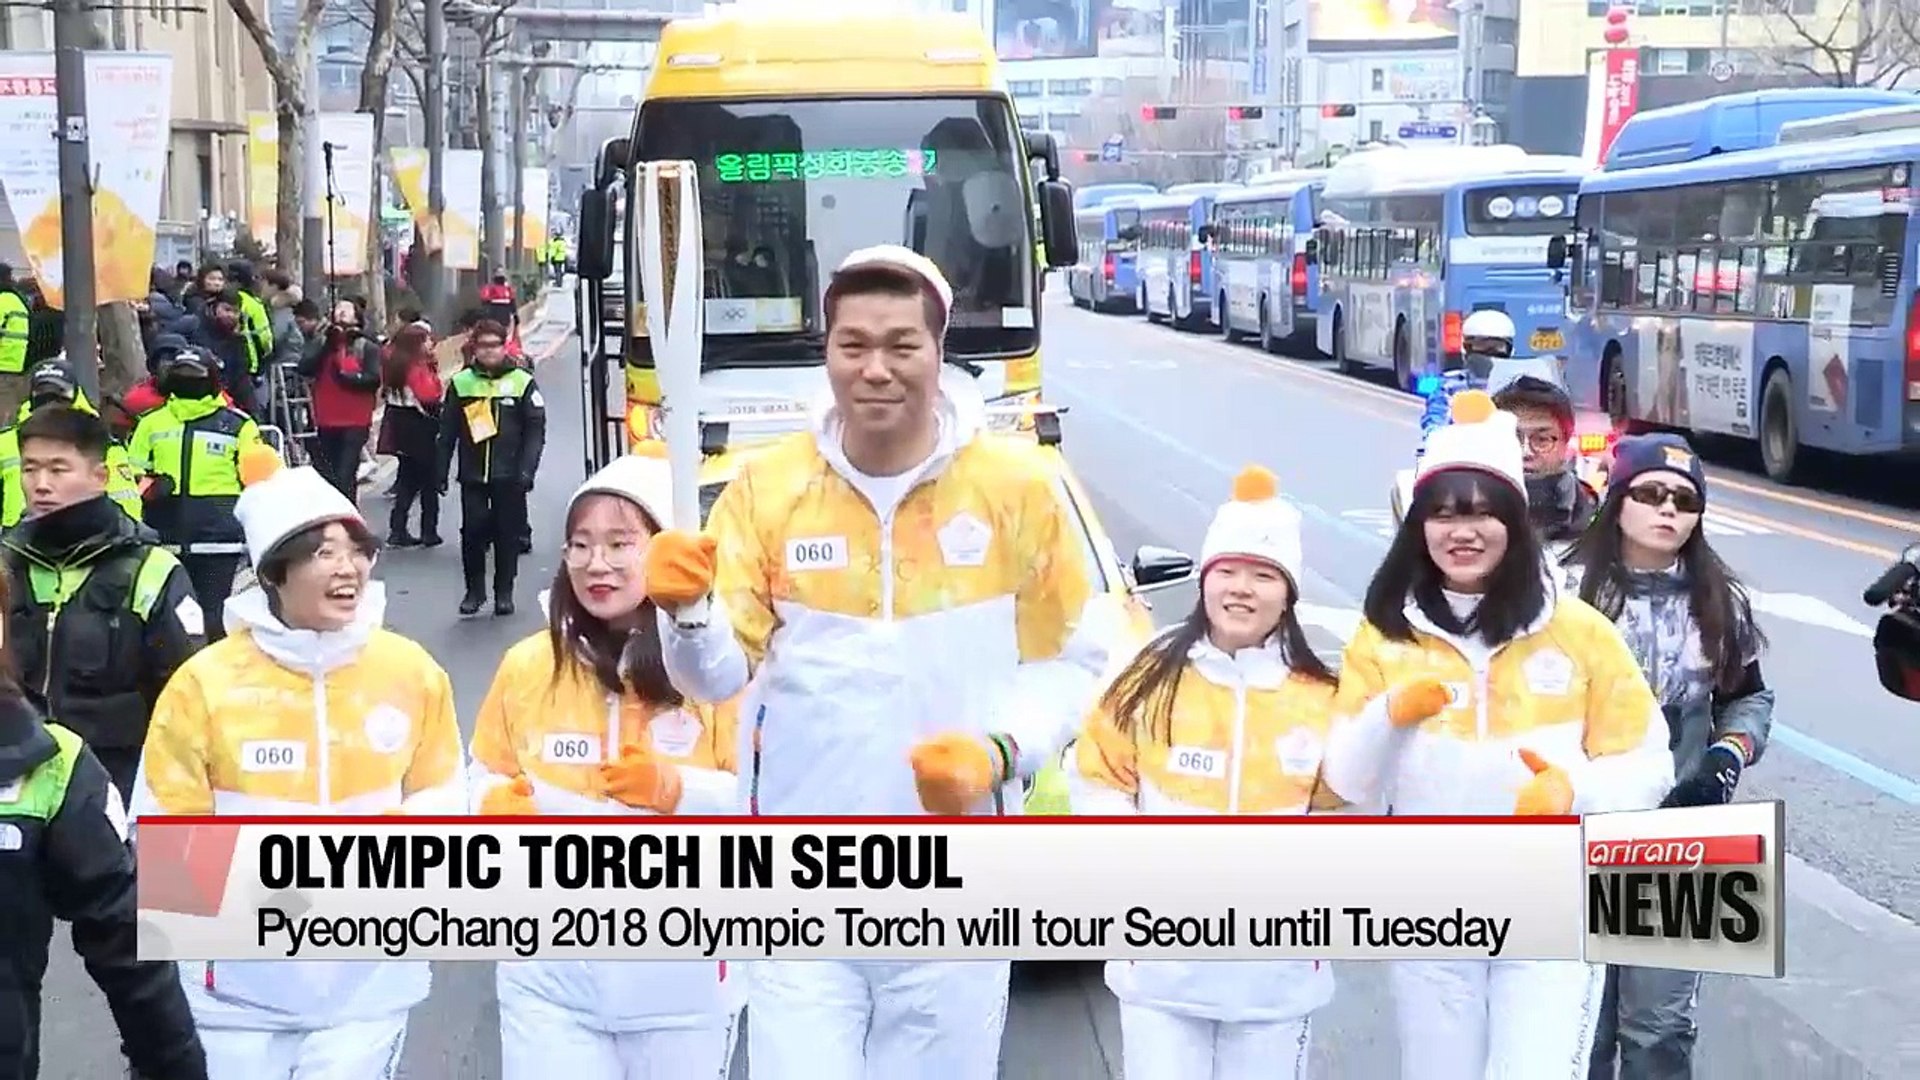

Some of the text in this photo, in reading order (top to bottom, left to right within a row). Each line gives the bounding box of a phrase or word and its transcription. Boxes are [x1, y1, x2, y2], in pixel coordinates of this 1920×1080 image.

[796, 543, 833, 563] 060
[255, 747, 294, 765] 060
[553, 739, 589, 758] 060
[1178, 752, 1214, 772] 060
